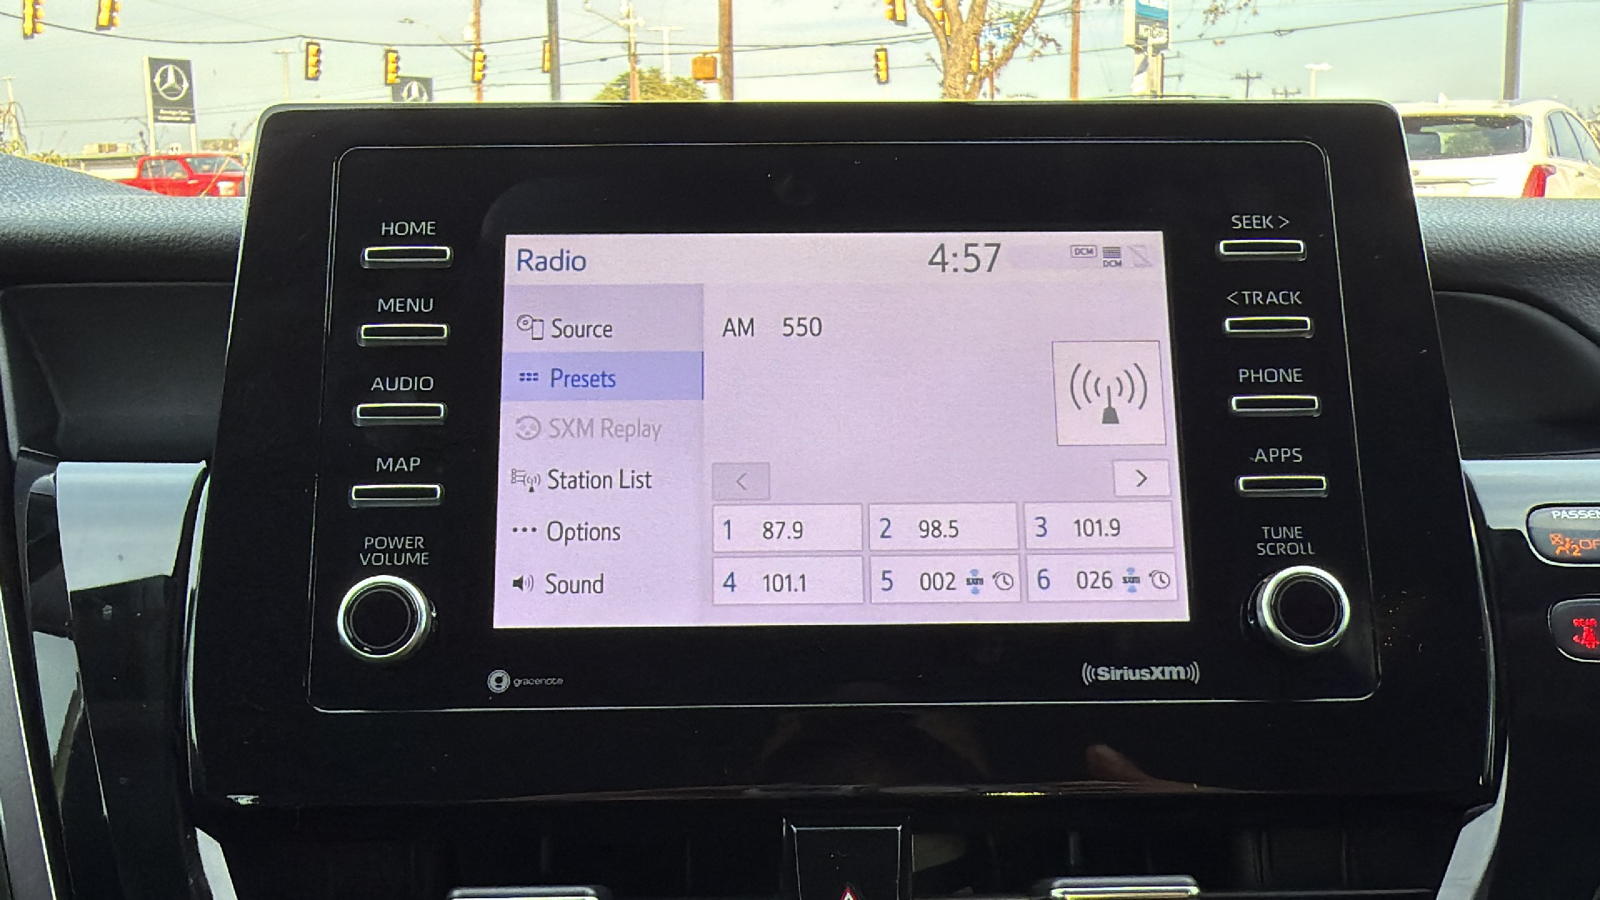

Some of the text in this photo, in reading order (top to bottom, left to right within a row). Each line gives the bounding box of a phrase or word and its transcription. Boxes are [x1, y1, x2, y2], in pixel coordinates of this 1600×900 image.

[381, 221, 436, 236] HOME
[1231, 215, 1274, 229] SEEK
[516, 248, 587, 271] Radio
[927, 243, 1002, 273] 4:57
[1074, 247, 1094, 256] DCM
[1103, 259, 1122, 267] DCM
[377, 298, 434, 313] MENU
[1241, 291, 1303, 305] TRACK
[551, 318, 613, 338] Source
[721, 316, 823, 337] AM 550
[370, 376, 435, 391] AUDIO
[550, 368, 617, 388] Presets
[1238, 368, 1304, 383] PHONE
[549, 418, 663, 442] SXM Replay
[1254, 447, 1303, 463] APPS
[375, 457, 421, 472] MAP
[547, 468, 653, 490] Station List
[546, 520, 621, 546] Options
[722, 519, 804, 540] 1 87.9
[879, 517, 960, 539] 2 98.5
[1034, 516, 1121, 537] 3 101.9
[1261, 526, 1304, 539] TUNE
[364, 536, 425, 550] POWER
[1256, 542, 1316, 556] SCROLL
[359, 552, 430, 566] VOLUME
[545, 573, 604, 594] Sound
[722, 571, 807, 593] 4 101.1
[880, 570, 894, 591] 5
[919, 572, 957, 591] 002
[1037, 568, 1051, 590] 6
[1076, 570, 1114, 590] 026
[513, 678, 564, 688] gracenote
